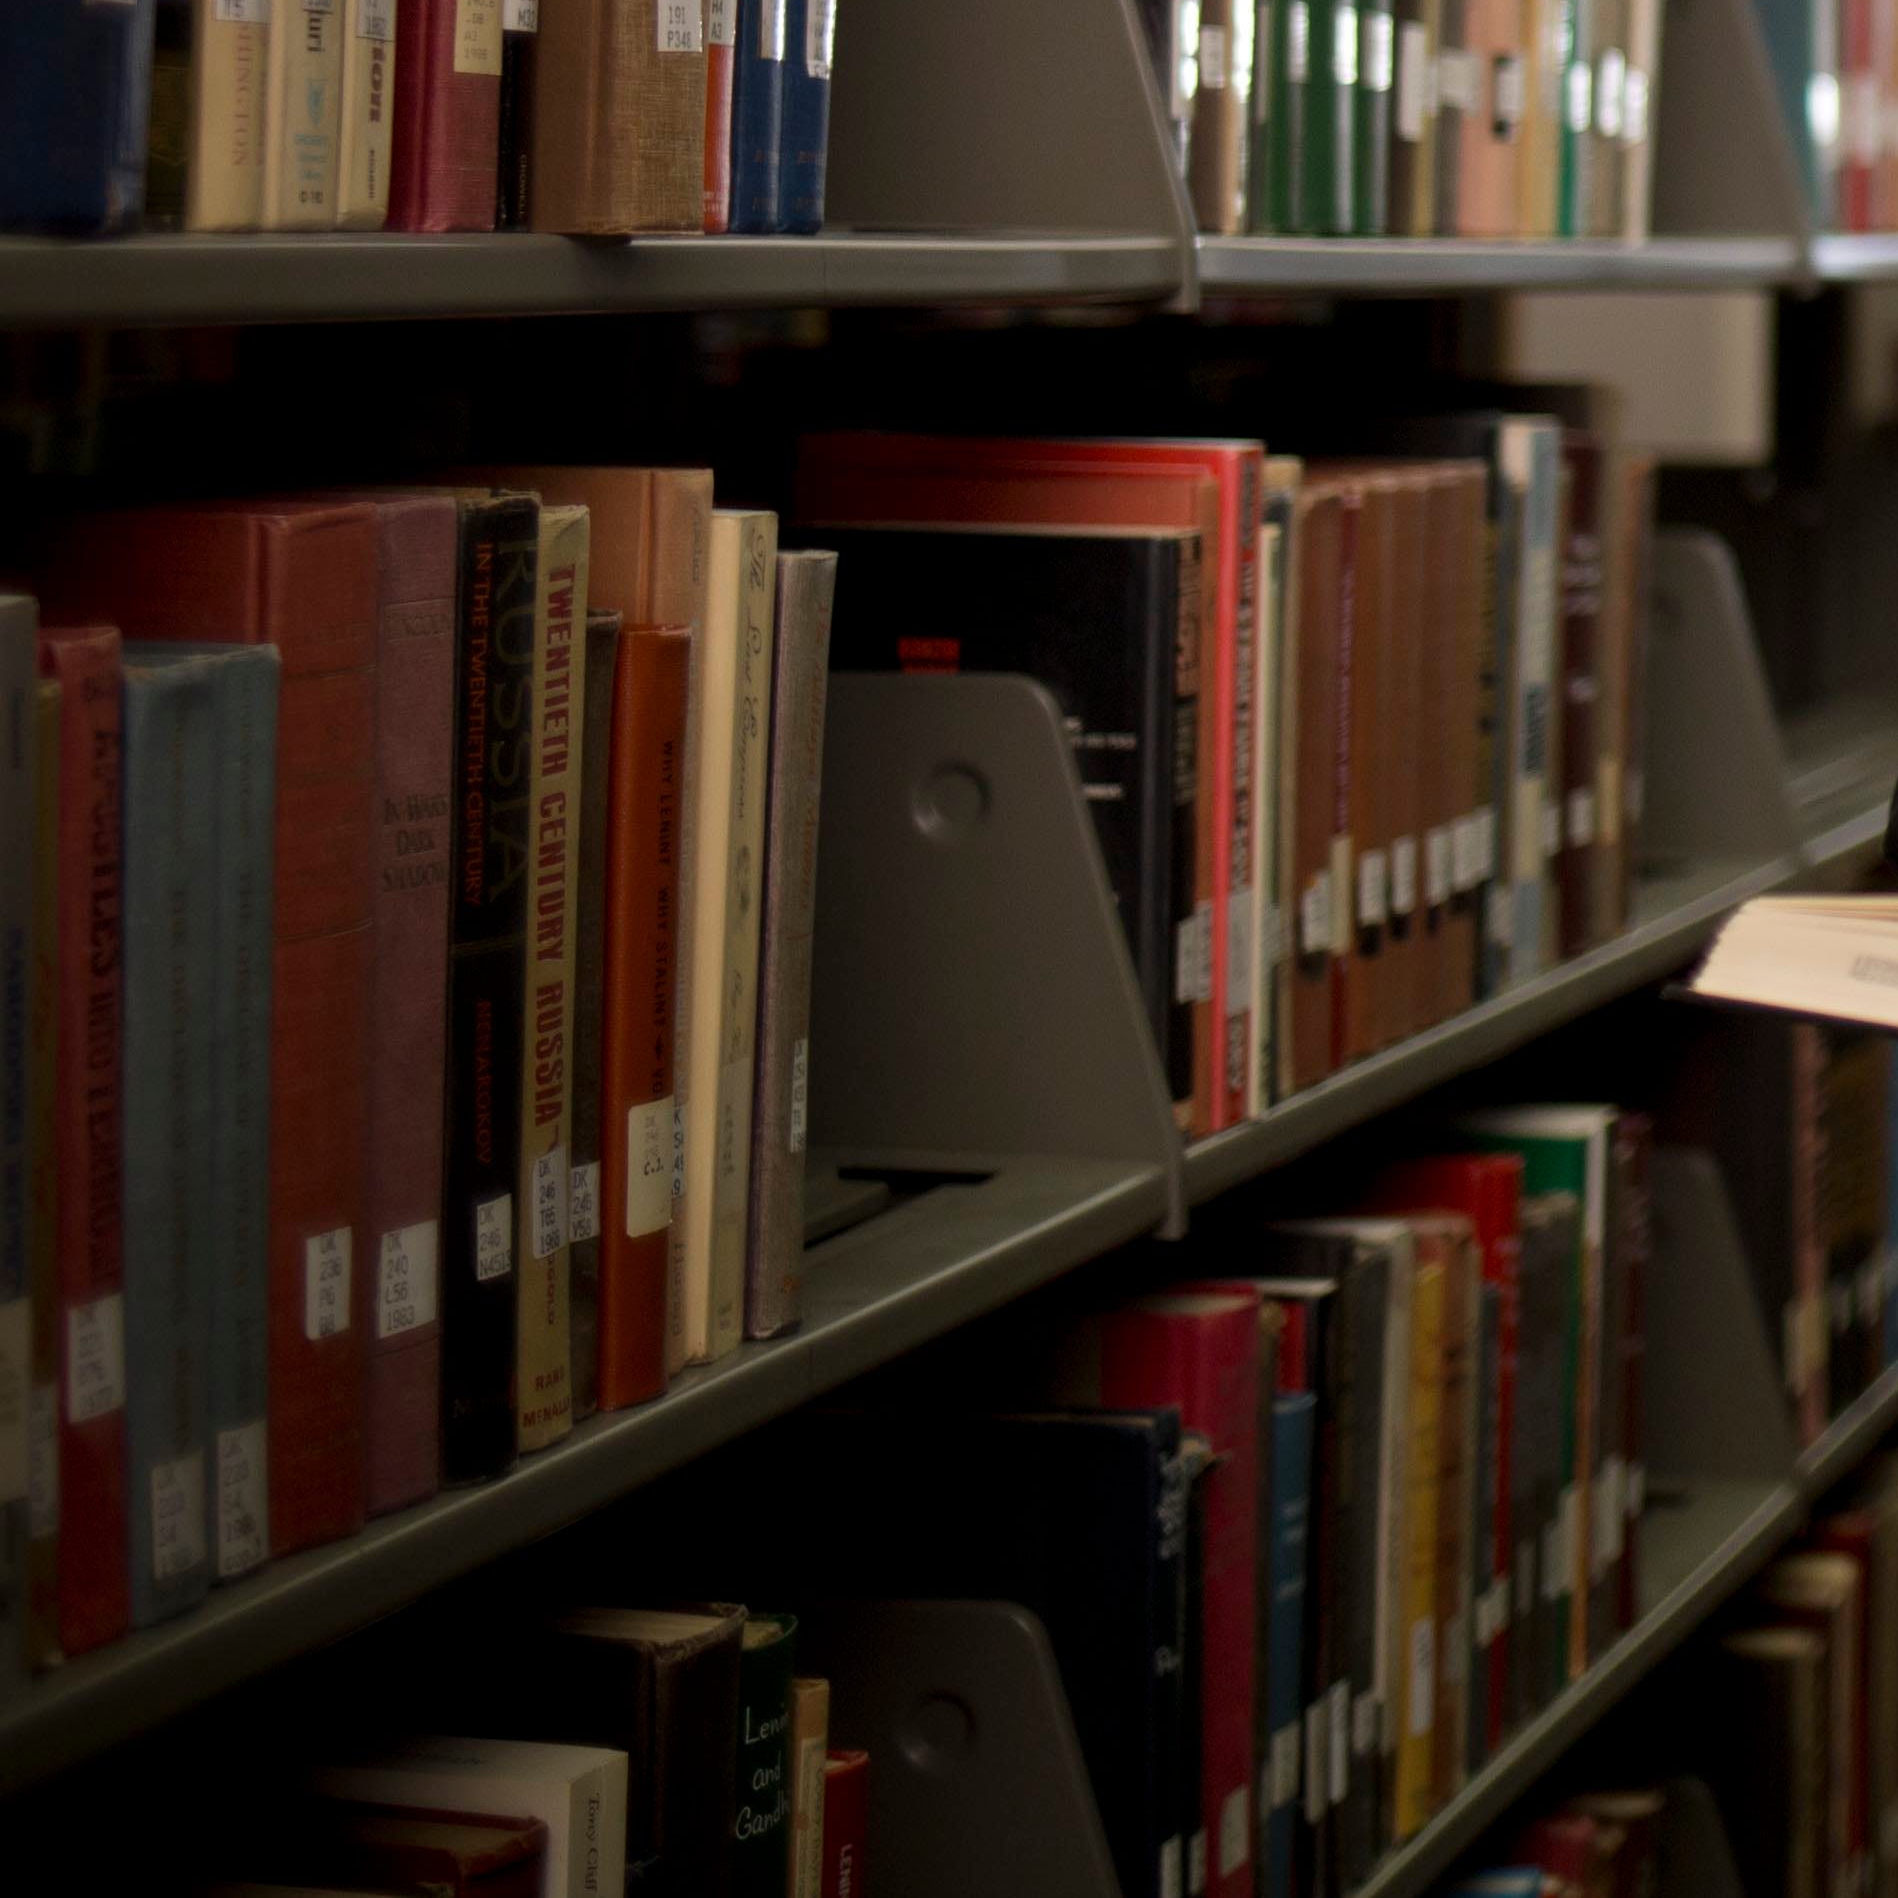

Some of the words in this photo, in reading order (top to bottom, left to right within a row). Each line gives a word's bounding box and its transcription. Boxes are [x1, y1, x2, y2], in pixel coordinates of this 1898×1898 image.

[668, 5, 687, 25] 191
[472, 540, 494, 570] IN
[469, 580, 491, 628] THE
[541, 564, 577, 776] TWENTIETH
[465, 635, 489, 783] TWENTIETH
[489, 538, 537, 904] RUSSIA
[663, 739, 675, 786] WHY
[461, 791, 485, 907] CENTURY
[537, 790, 567, 961] CENTURY
[656, 886, 670, 931] WHY
[535, 980, 564, 1127] RUSSIA
[538, 1182, 557, 1202] 246
[573, 1170, 589, 1190] DK
[752, 1749, 783, 1792] and
[585, 1790, 601, 1838] Tony
[582, 1847, 600, 1894] Cliff
